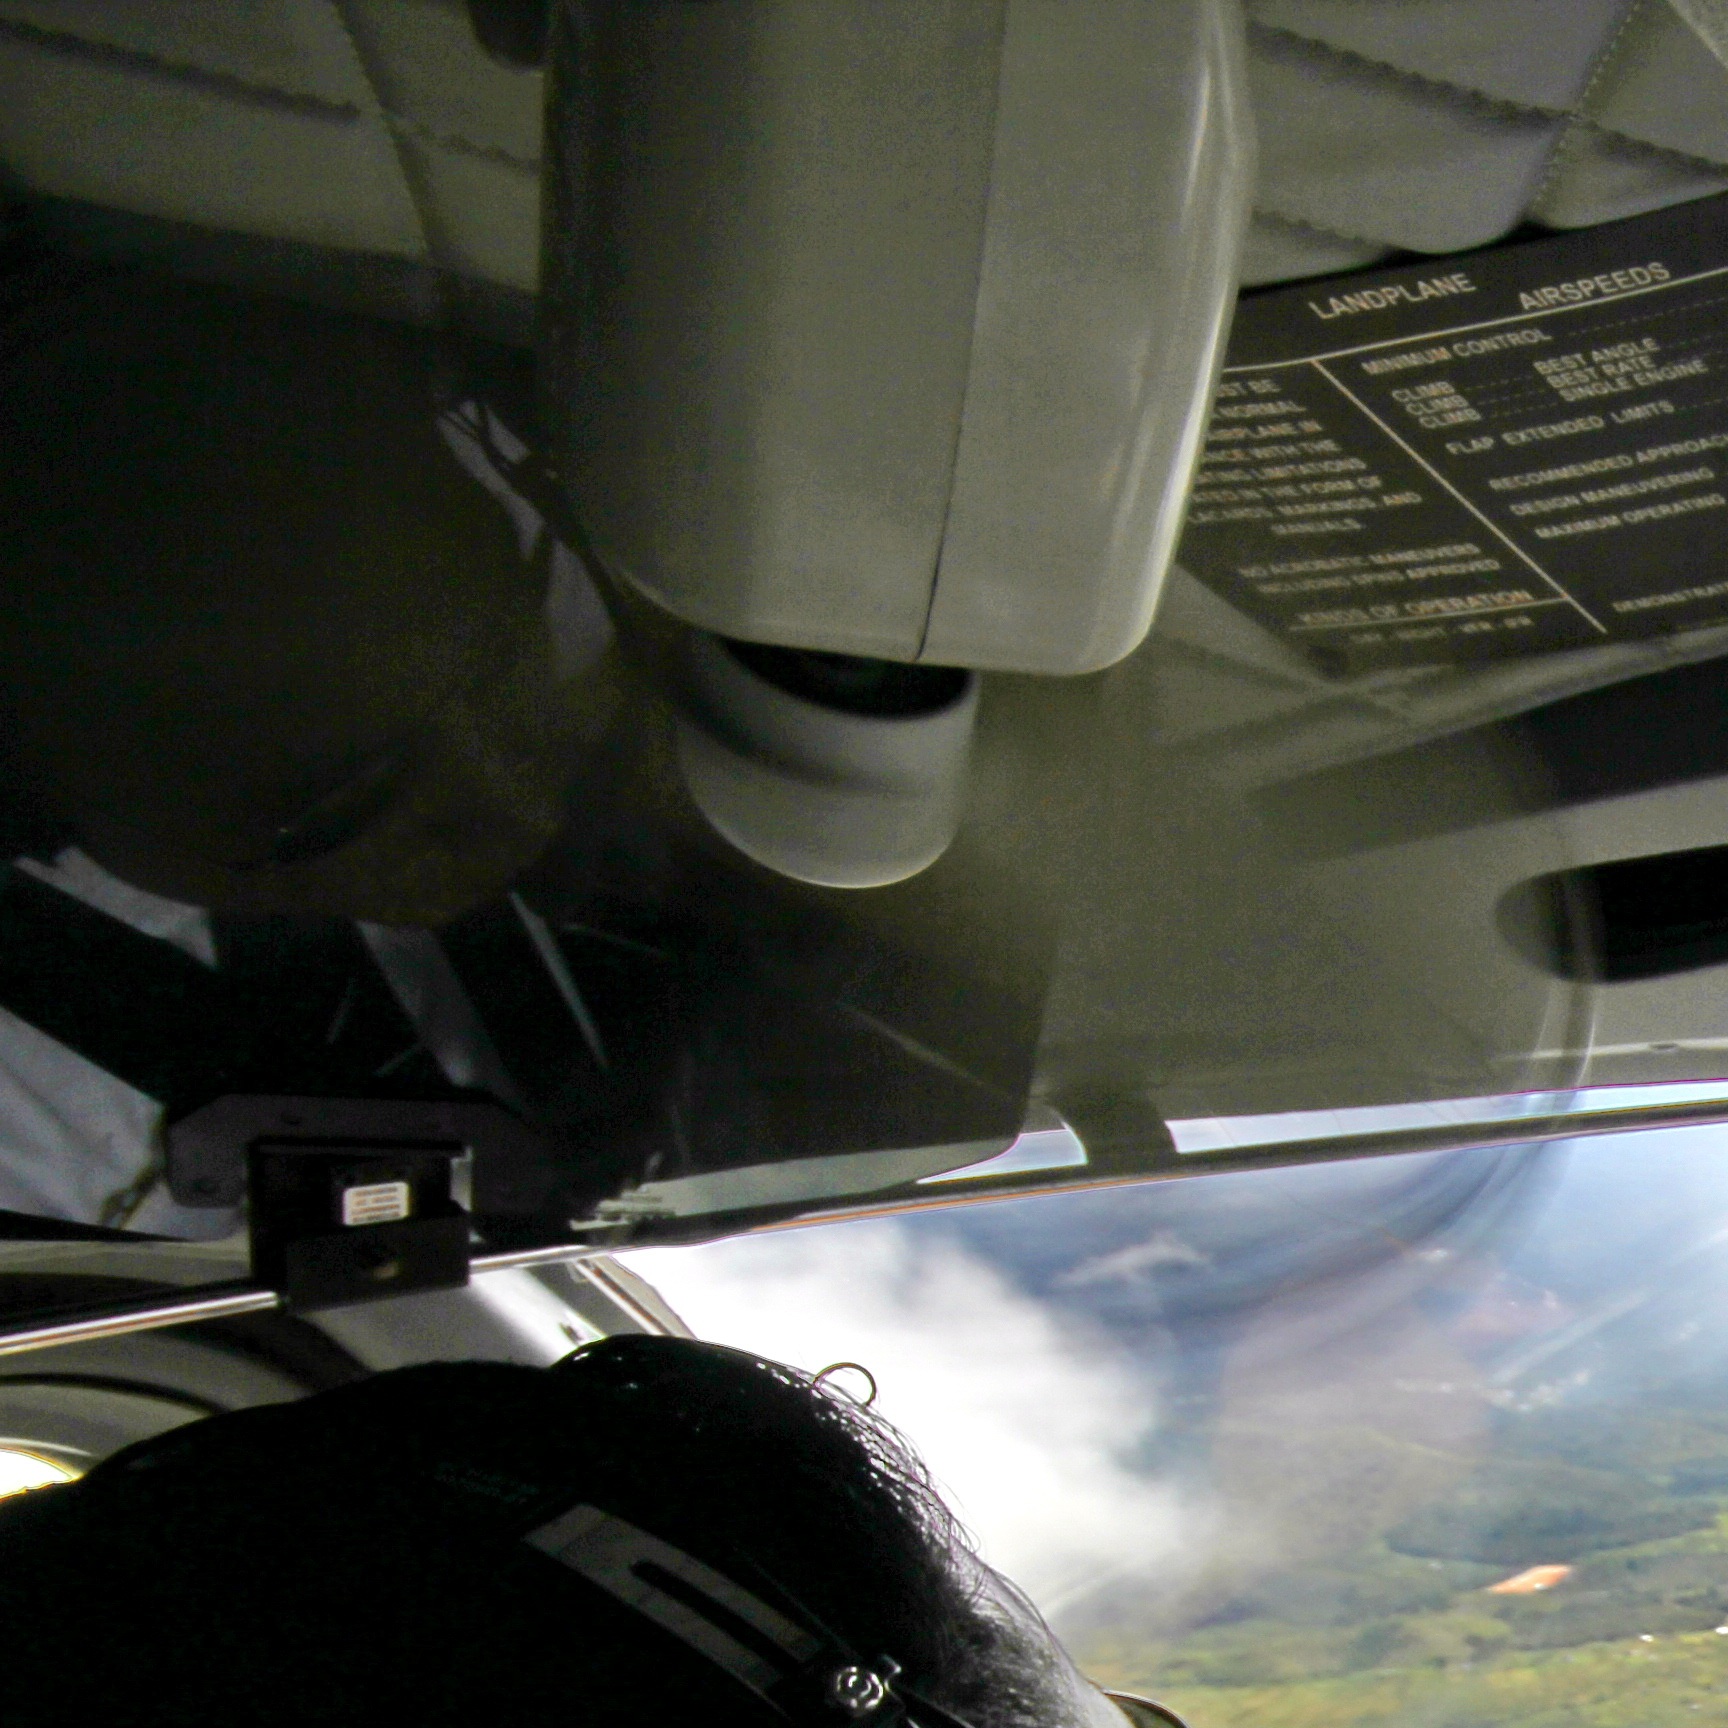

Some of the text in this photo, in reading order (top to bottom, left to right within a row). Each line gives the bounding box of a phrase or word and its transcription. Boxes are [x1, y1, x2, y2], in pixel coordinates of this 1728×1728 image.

[1308, 262, 1670, 320] LANDPLANE AIRSPEEDS
[1362, 346, 1453, 375] MINIMUM
[1453, 329, 1552, 358] CONTROL
[1392, 382, 1455, 404] CLIMB
[1591, 338, 1660, 363] ANGLE
[1405, 395, 1469, 417] CLIMB
[1502, 416, 1605, 445] EXTENDED
[1610, 400, 1675, 425] LIMITS
